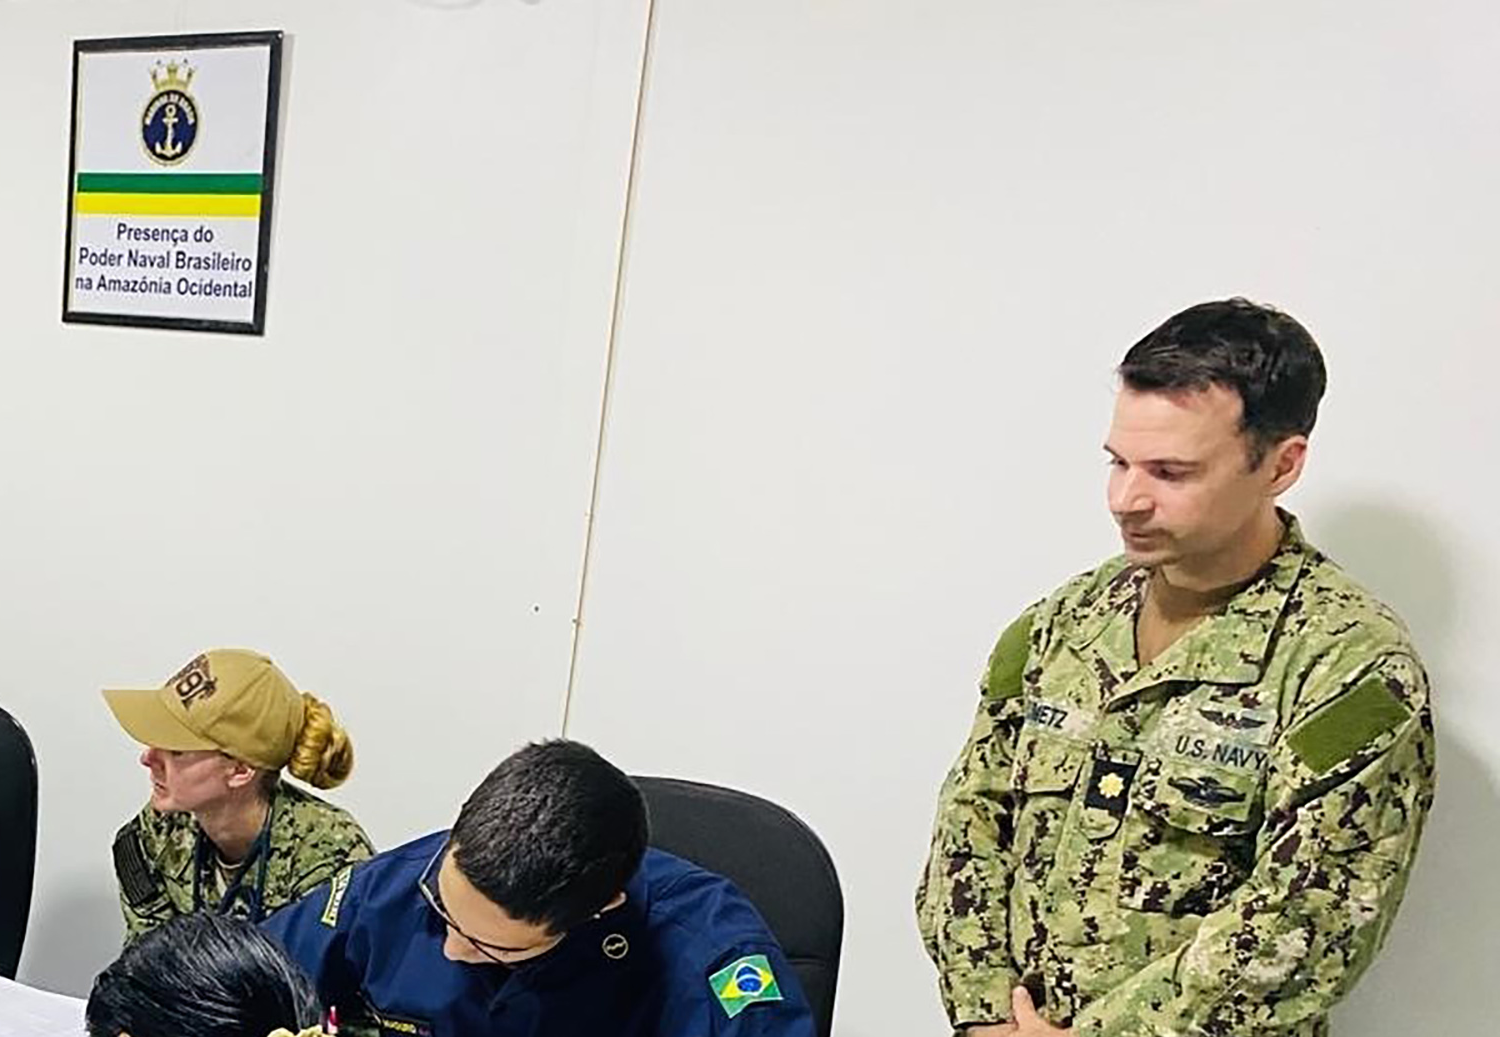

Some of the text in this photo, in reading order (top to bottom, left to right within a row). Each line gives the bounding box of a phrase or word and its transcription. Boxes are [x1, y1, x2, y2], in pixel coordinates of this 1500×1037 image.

[116, 223, 214, 247] Presença do
[78, 247, 252, 272] Poder Naval Brasileiro
[75, 276, 93, 290] na
[176, 277, 253, 298] Ocidental
[1175, 734, 1268, 771] U.S. NAVY
